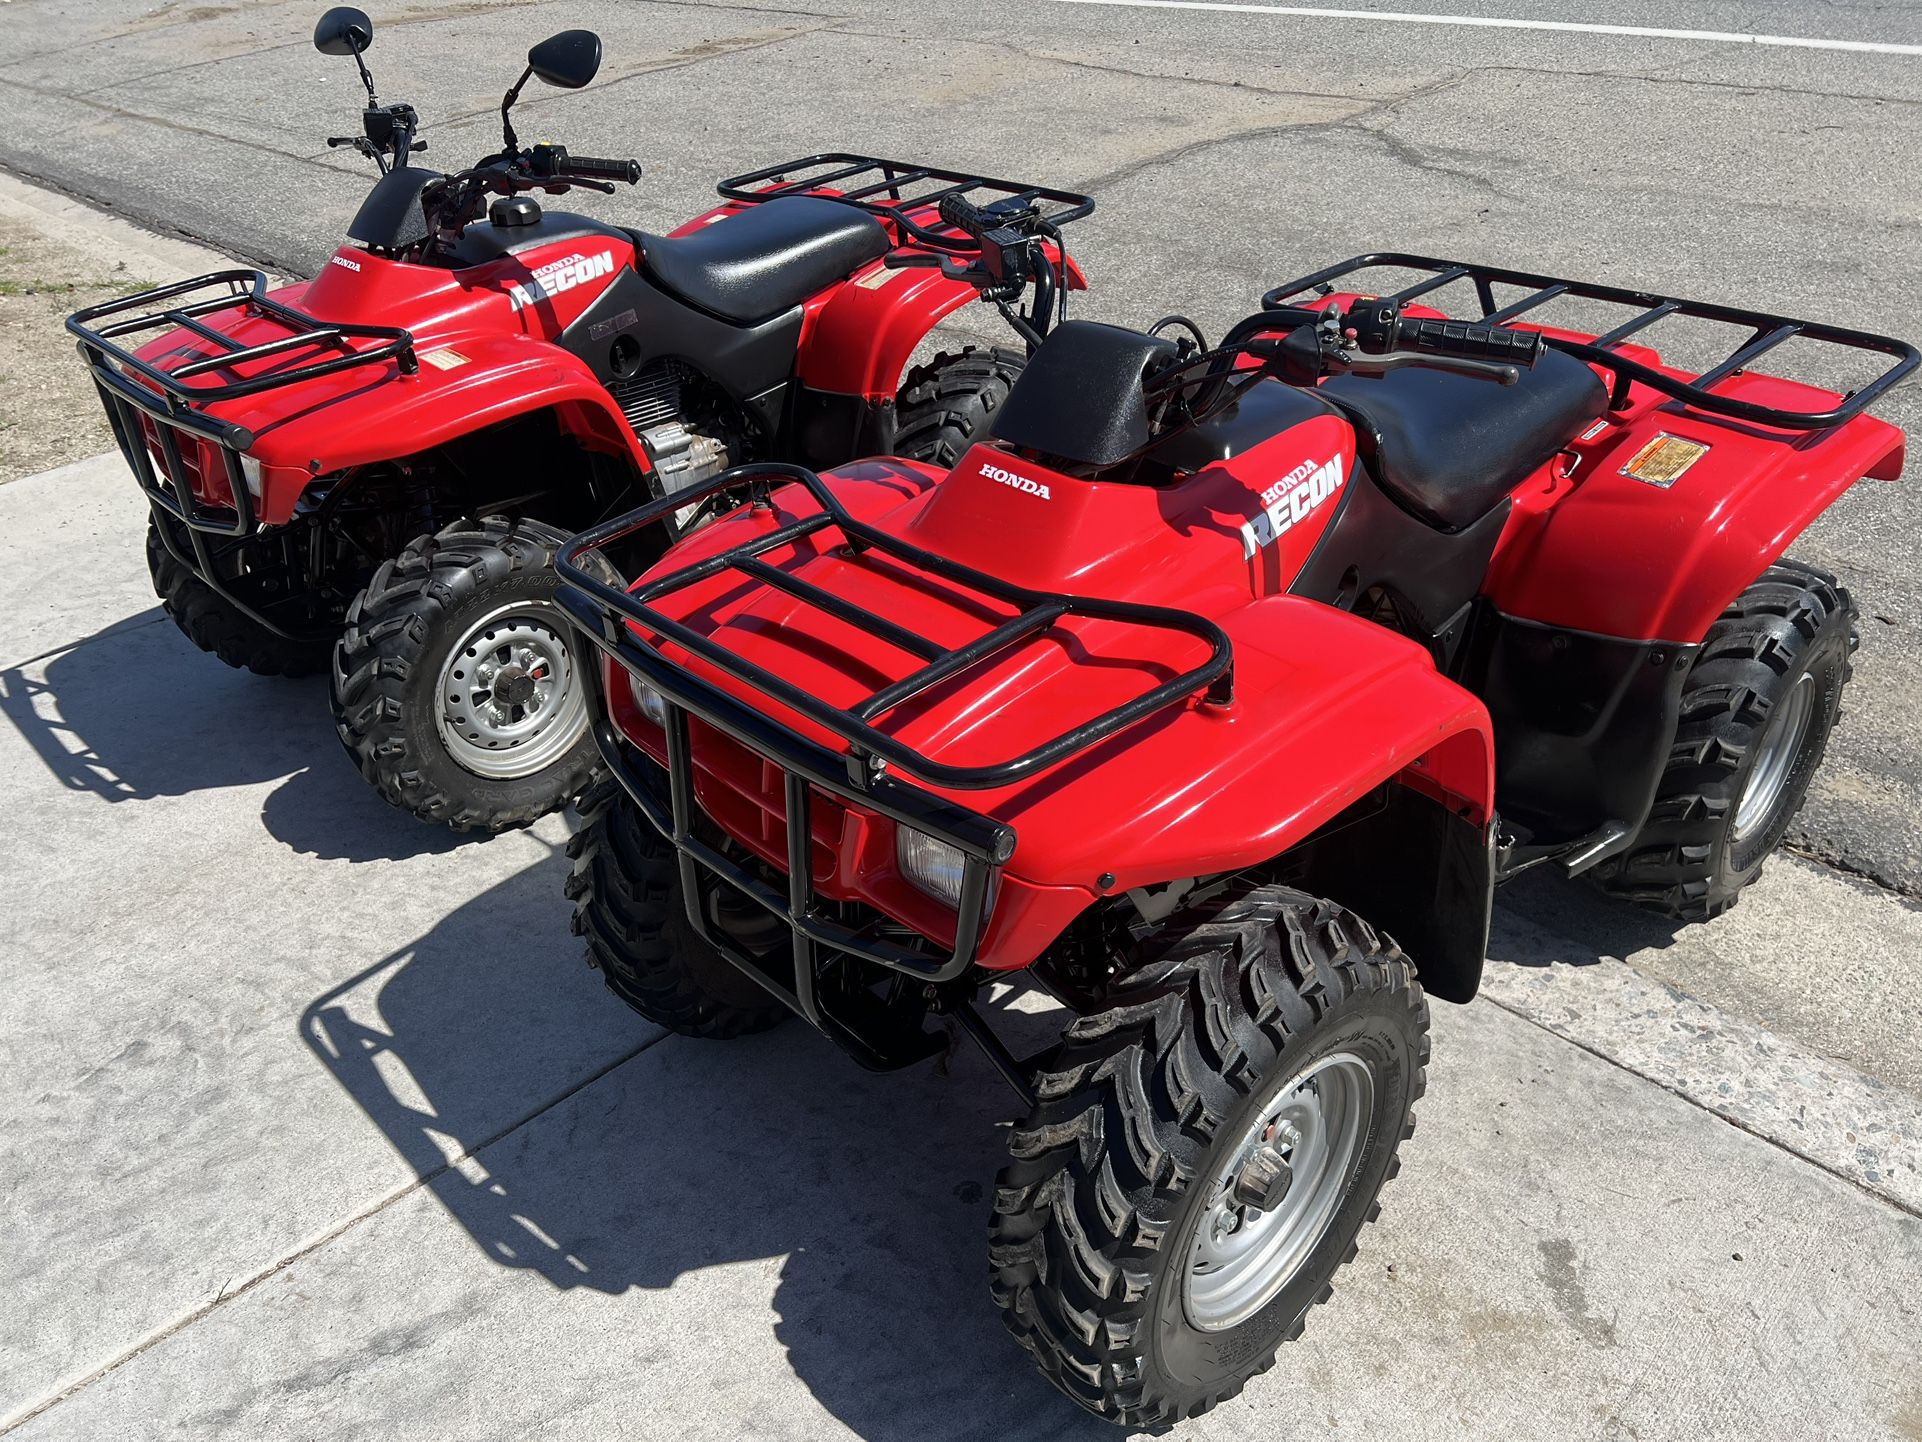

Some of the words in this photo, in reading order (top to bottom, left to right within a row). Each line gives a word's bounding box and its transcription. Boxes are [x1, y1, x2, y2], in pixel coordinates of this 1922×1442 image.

[331, 255, 361, 272] HONDA
[510, 250, 614, 313] RECON
[530, 253, 586, 279] HONDA
[978, 463, 1051, 500] HONDA
[1260, 459, 1319, 505] HONDA
[1241, 451, 1343, 561] RECON
